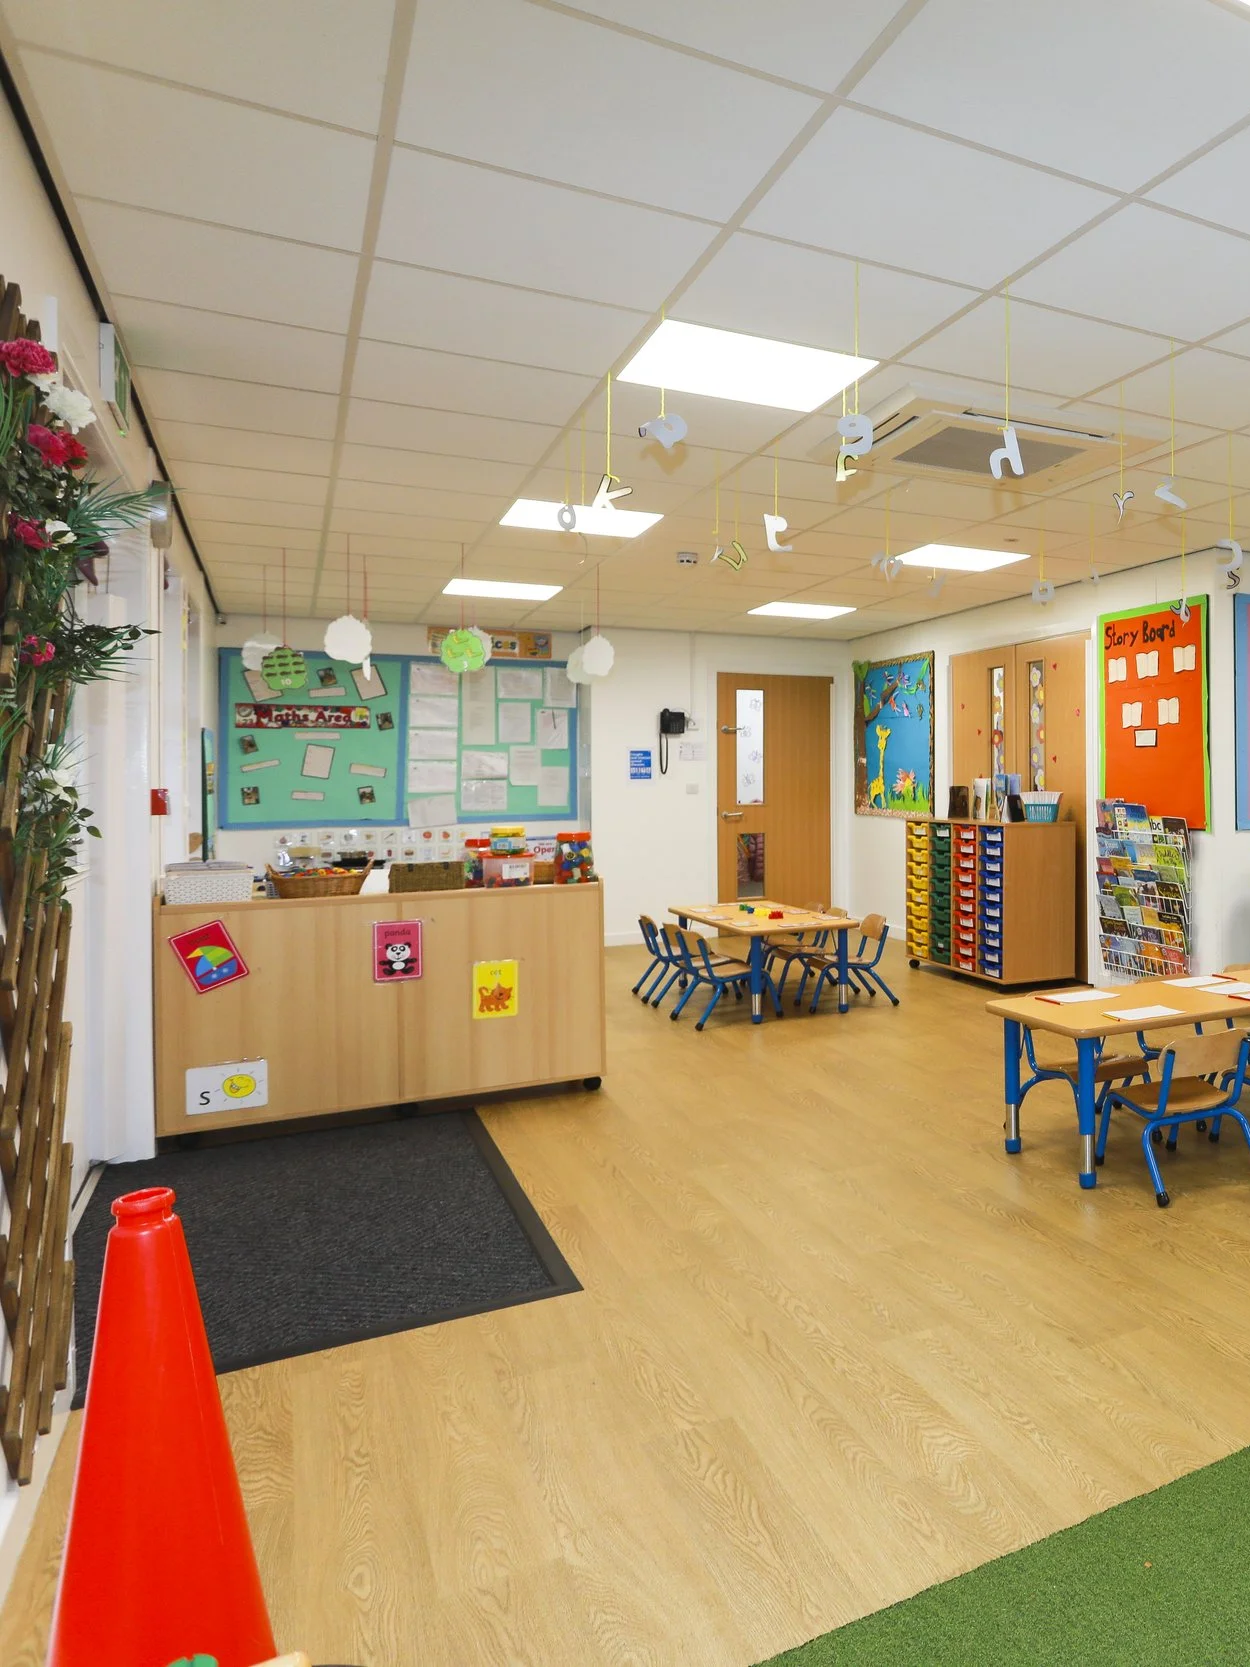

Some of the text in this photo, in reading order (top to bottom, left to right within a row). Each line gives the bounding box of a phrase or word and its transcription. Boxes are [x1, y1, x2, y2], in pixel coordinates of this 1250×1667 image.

[1104, 620, 1175, 650] Story Board
[256, 710, 309, 723] Maths
[315, 711, 352, 723] Area
[384, 929, 411, 938] panda
